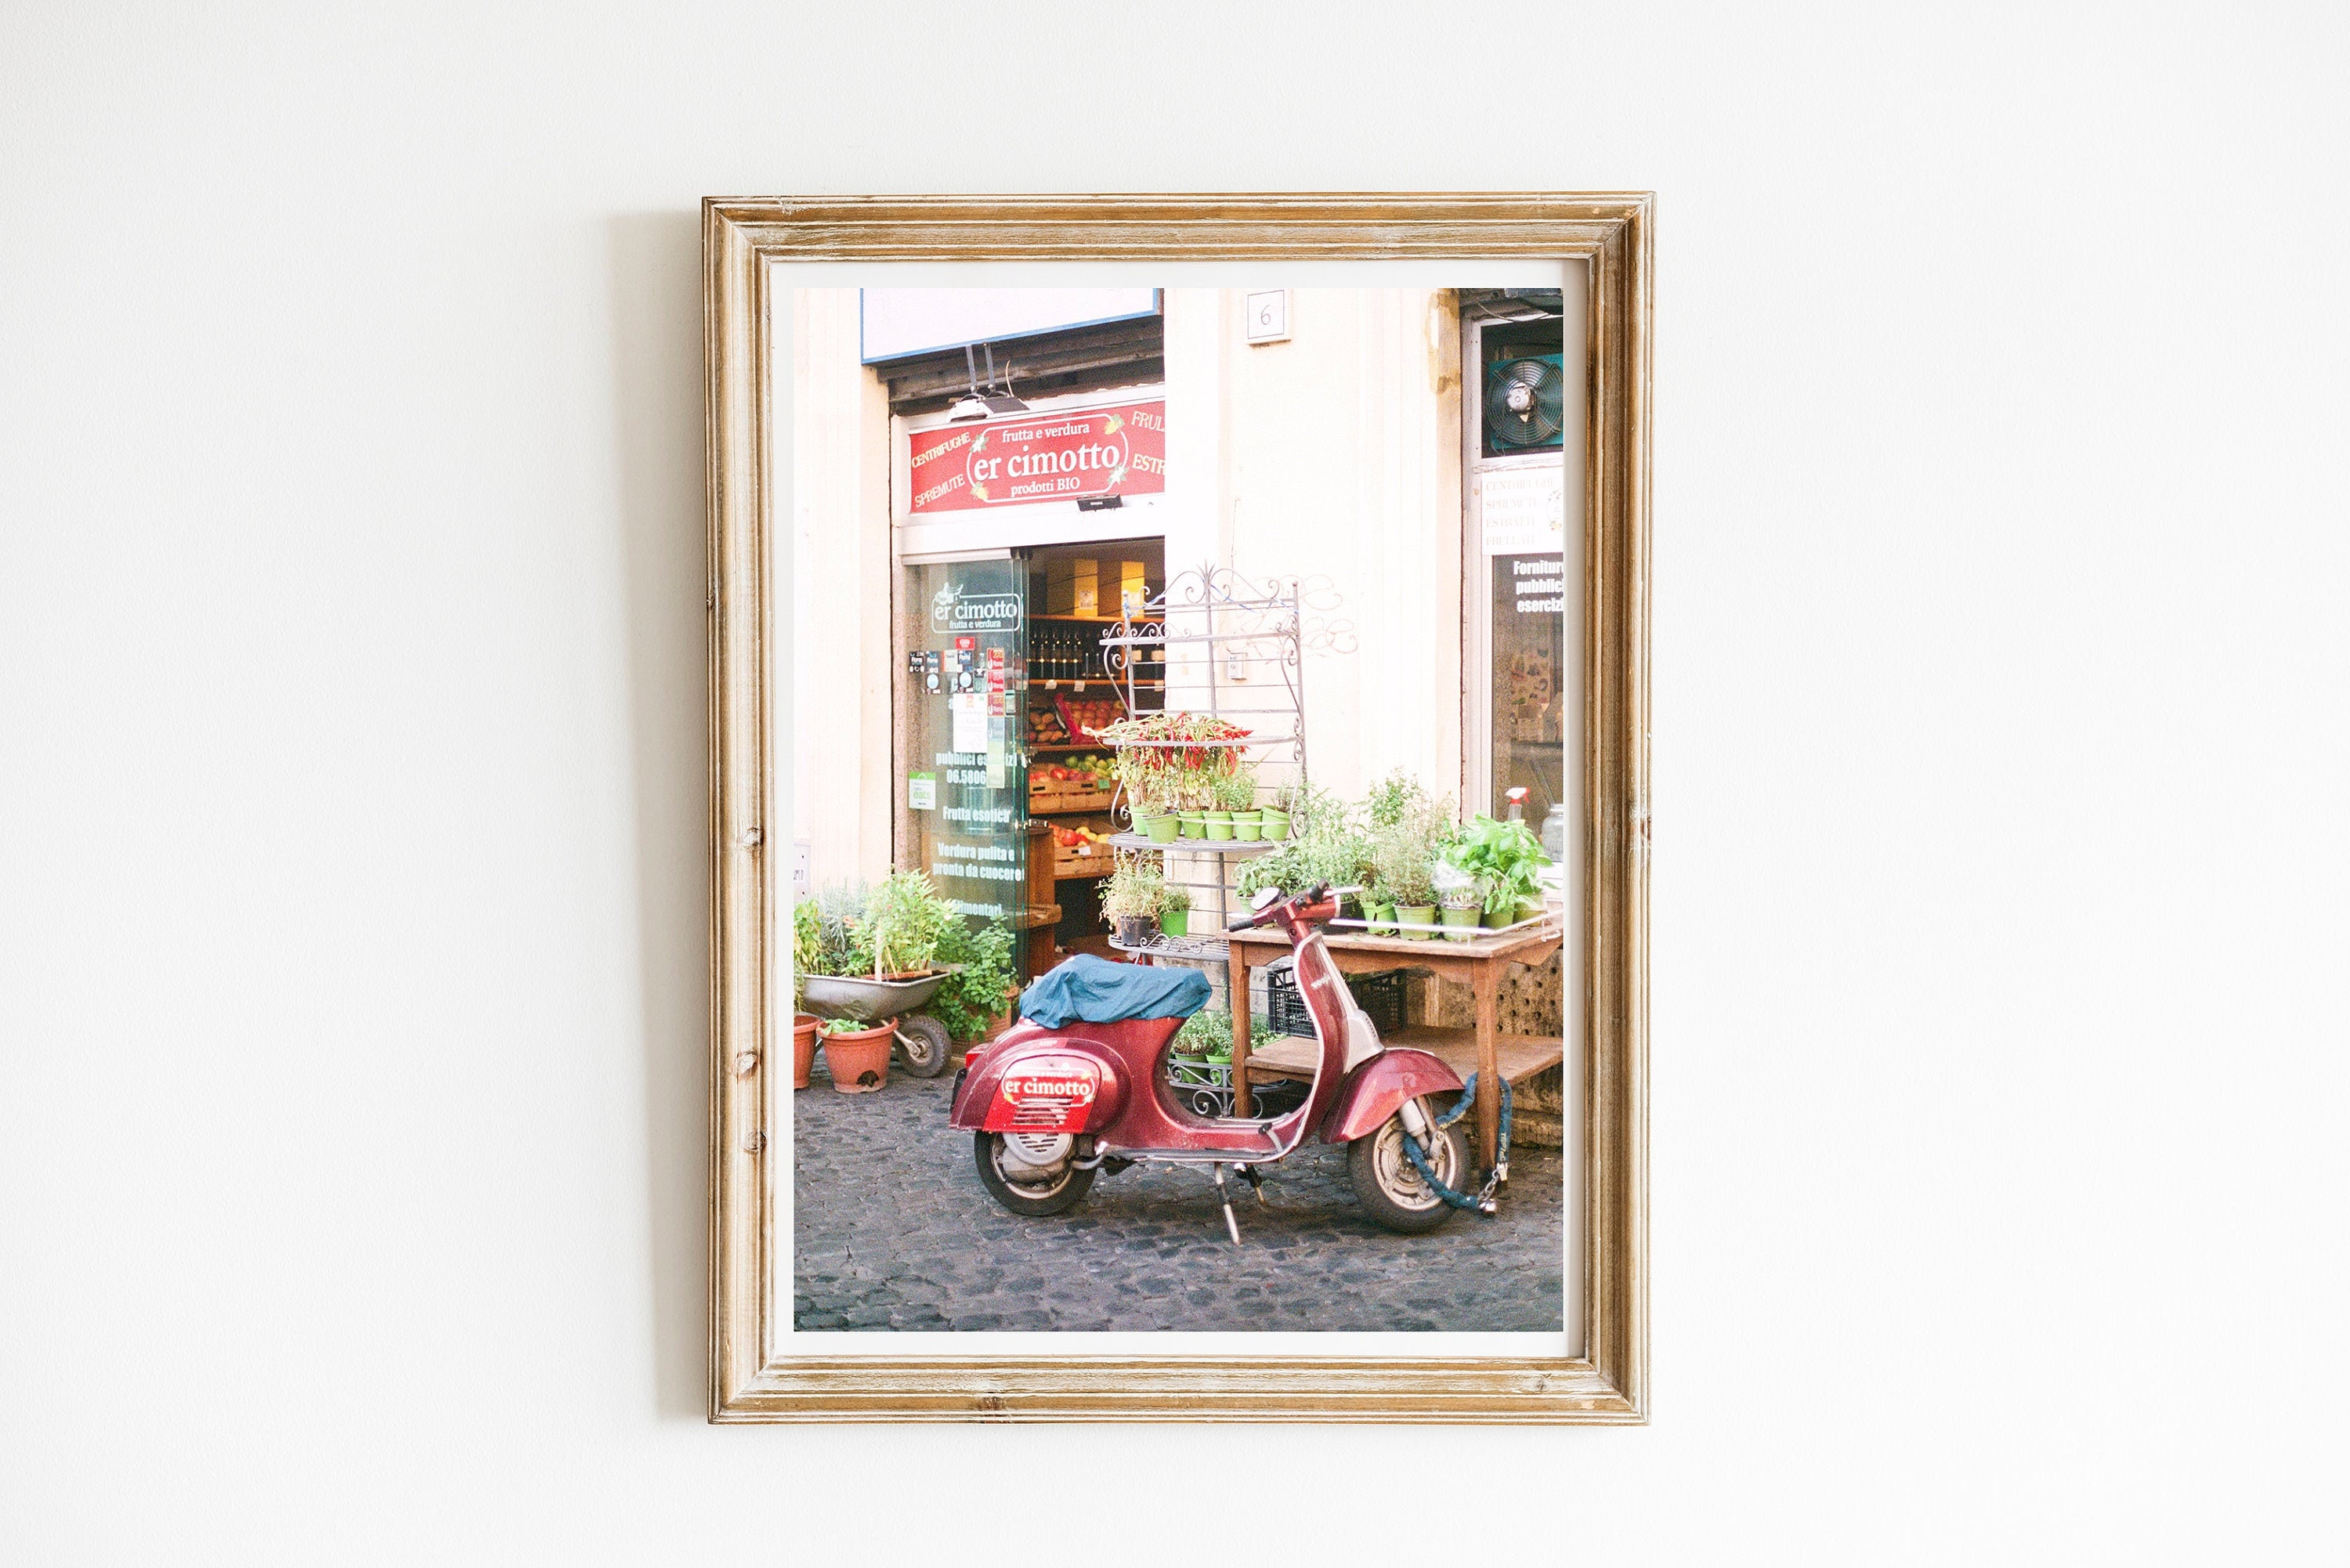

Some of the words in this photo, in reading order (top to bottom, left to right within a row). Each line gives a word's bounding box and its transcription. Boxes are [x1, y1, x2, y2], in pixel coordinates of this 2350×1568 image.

[1260, 304, 1271, 326] 6
[1002, 429, 1034, 443] frutta
[1036, 429, 1043, 439] e
[1045, 423, 1090, 438] verdura
[911, 432, 971, 468] CENTRIFUGHE
[974, 457, 1002, 481] er
[1007, 443, 1120, 478] cimotto
[914, 473, 966, 508] SPREMUTE
[1010, 479, 1054, 497] prodotti
[1057, 476, 1080, 491] BIO
[935, 605, 952, 620] er
[955, 600, 1018, 620] cimotto
[949, 620, 967, 630] frutta
[974, 619, 1001, 628] verdura
[977, 753, 1018, 768] esizi
[942, 806, 971, 822] Frutta
[972, 807, 1010, 823] esotica
[938, 842, 976, 858] Verdura
[978, 845, 1007, 861] pulita
[1008, 848, 1015, 862] e
[933, 862, 964, 877] pronta
[965, 863, 978, 878] da
[1005, 1081, 1021, 1094] er
[1024, 1078, 1090, 1096] cimotto
